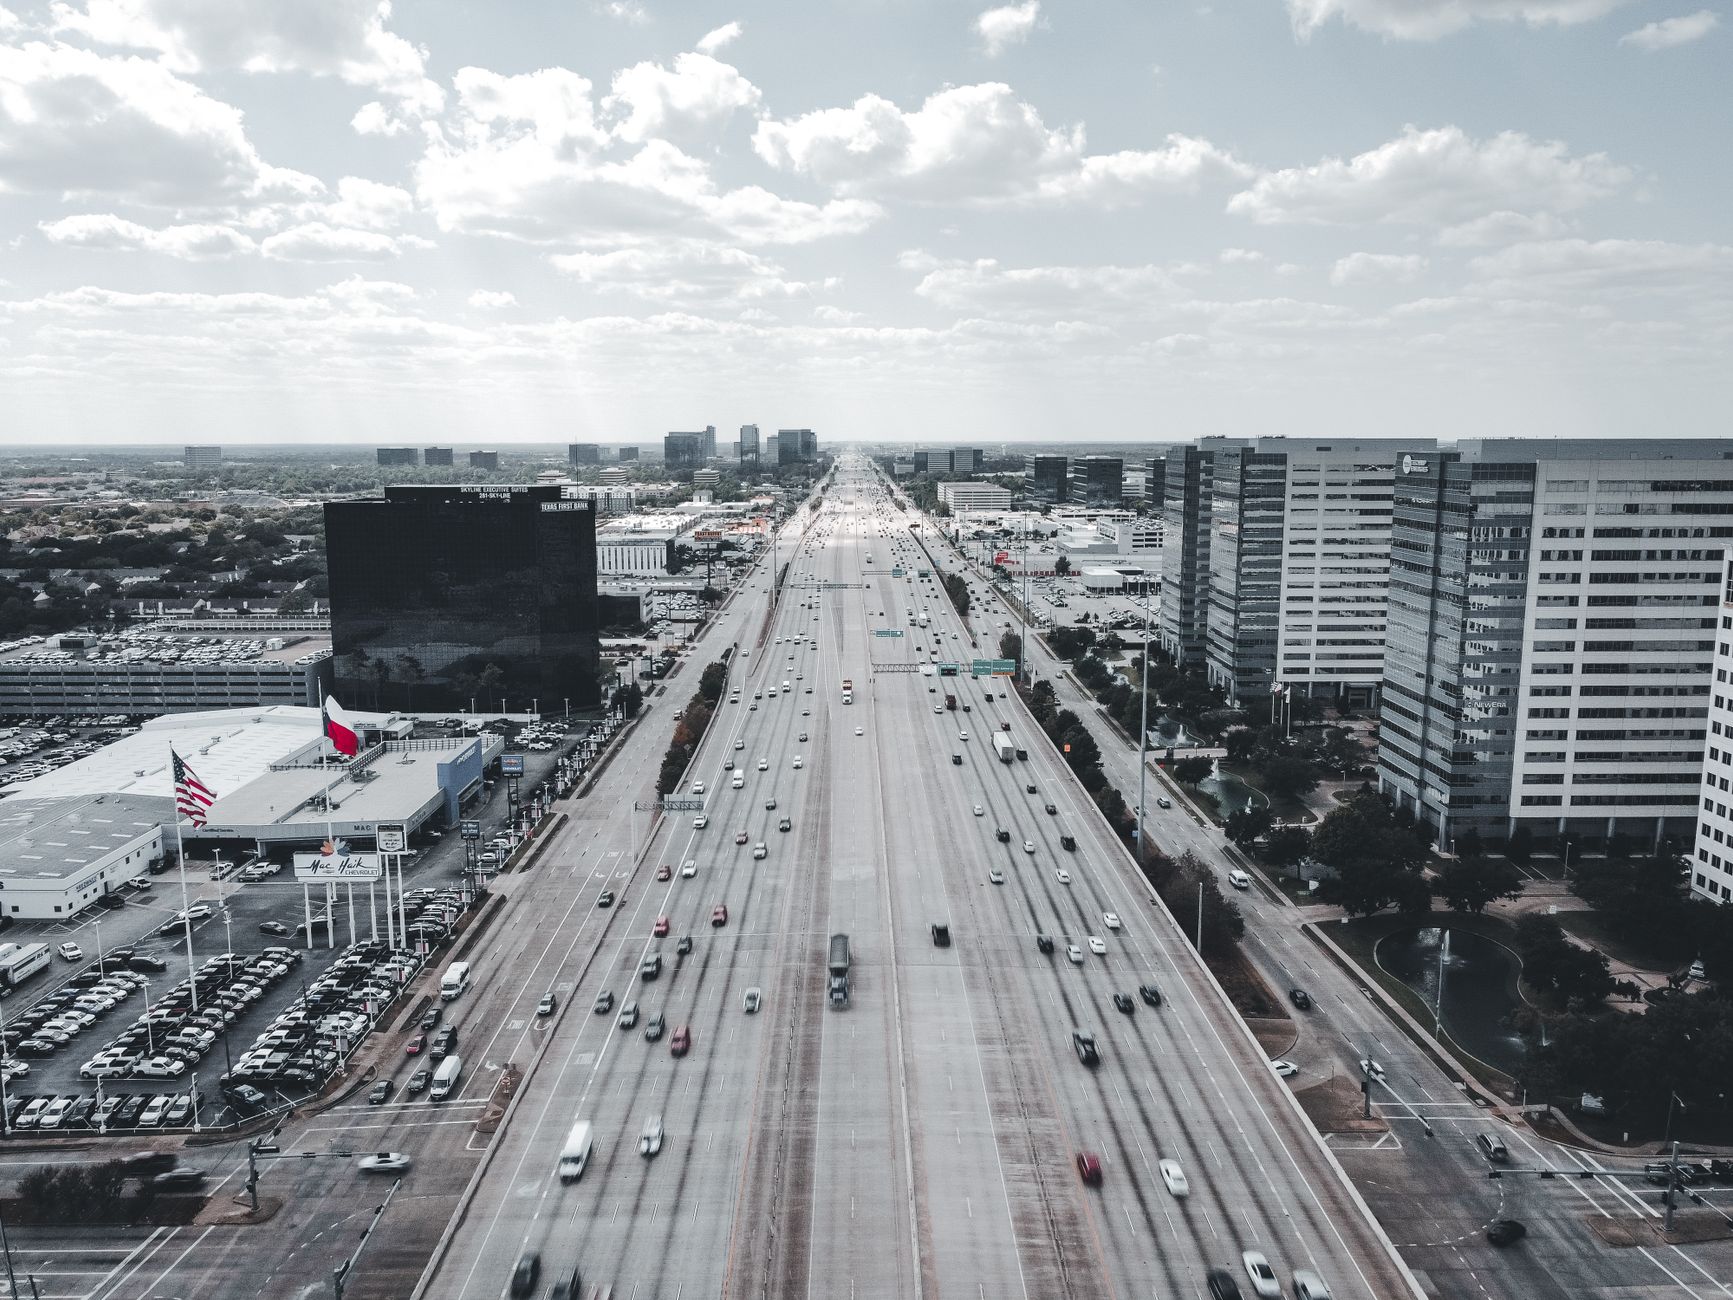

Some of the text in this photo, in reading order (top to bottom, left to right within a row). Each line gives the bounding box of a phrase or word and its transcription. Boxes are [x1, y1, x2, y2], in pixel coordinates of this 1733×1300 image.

[574, 502, 588, 510] BANK
[304, 857, 368, 875] Mac Haik
